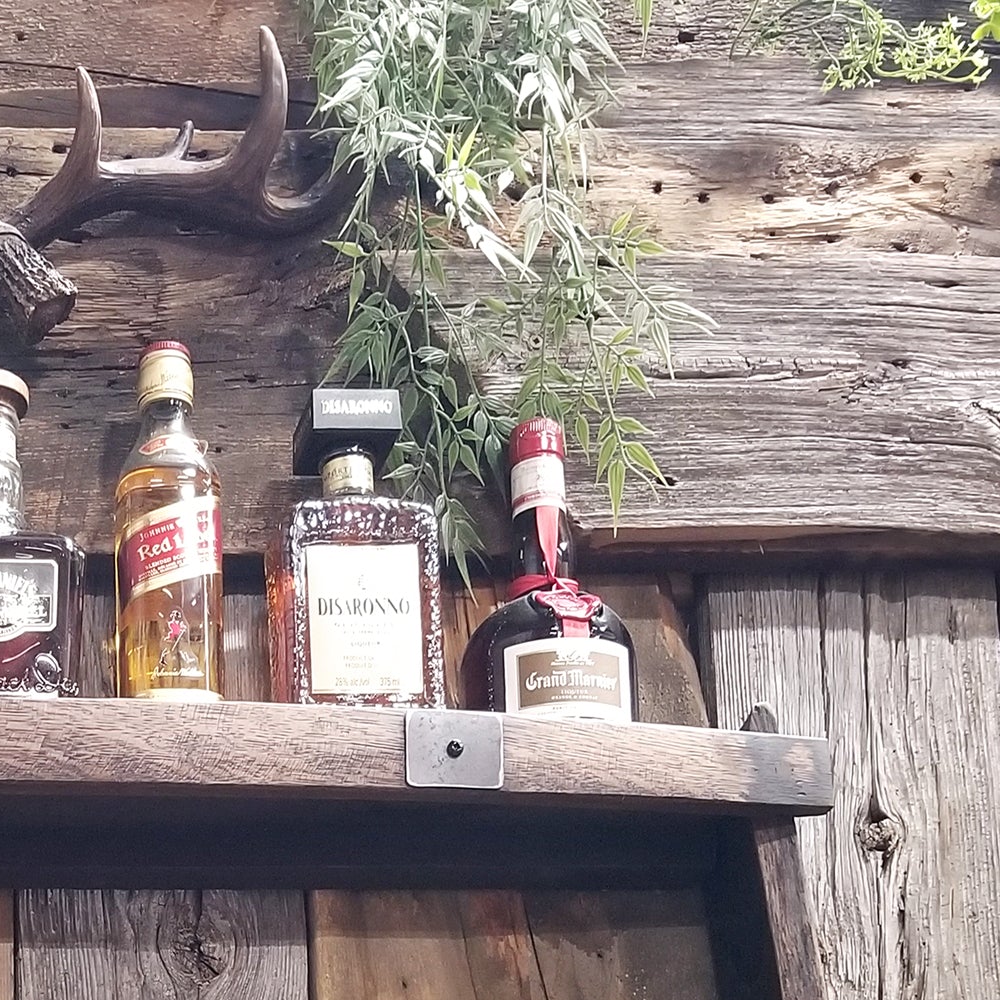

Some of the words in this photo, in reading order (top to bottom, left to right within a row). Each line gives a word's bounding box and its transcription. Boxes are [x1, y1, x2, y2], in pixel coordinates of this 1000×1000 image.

[320, 399, 393, 415] DISARONNO
[137, 536, 174, 562] Red
[317, 597, 410, 616] DISARONNO
[379, 676, 392, 687] 375
[525, 670, 567, 692] Grand
[567, 668, 617, 692] Marnier
